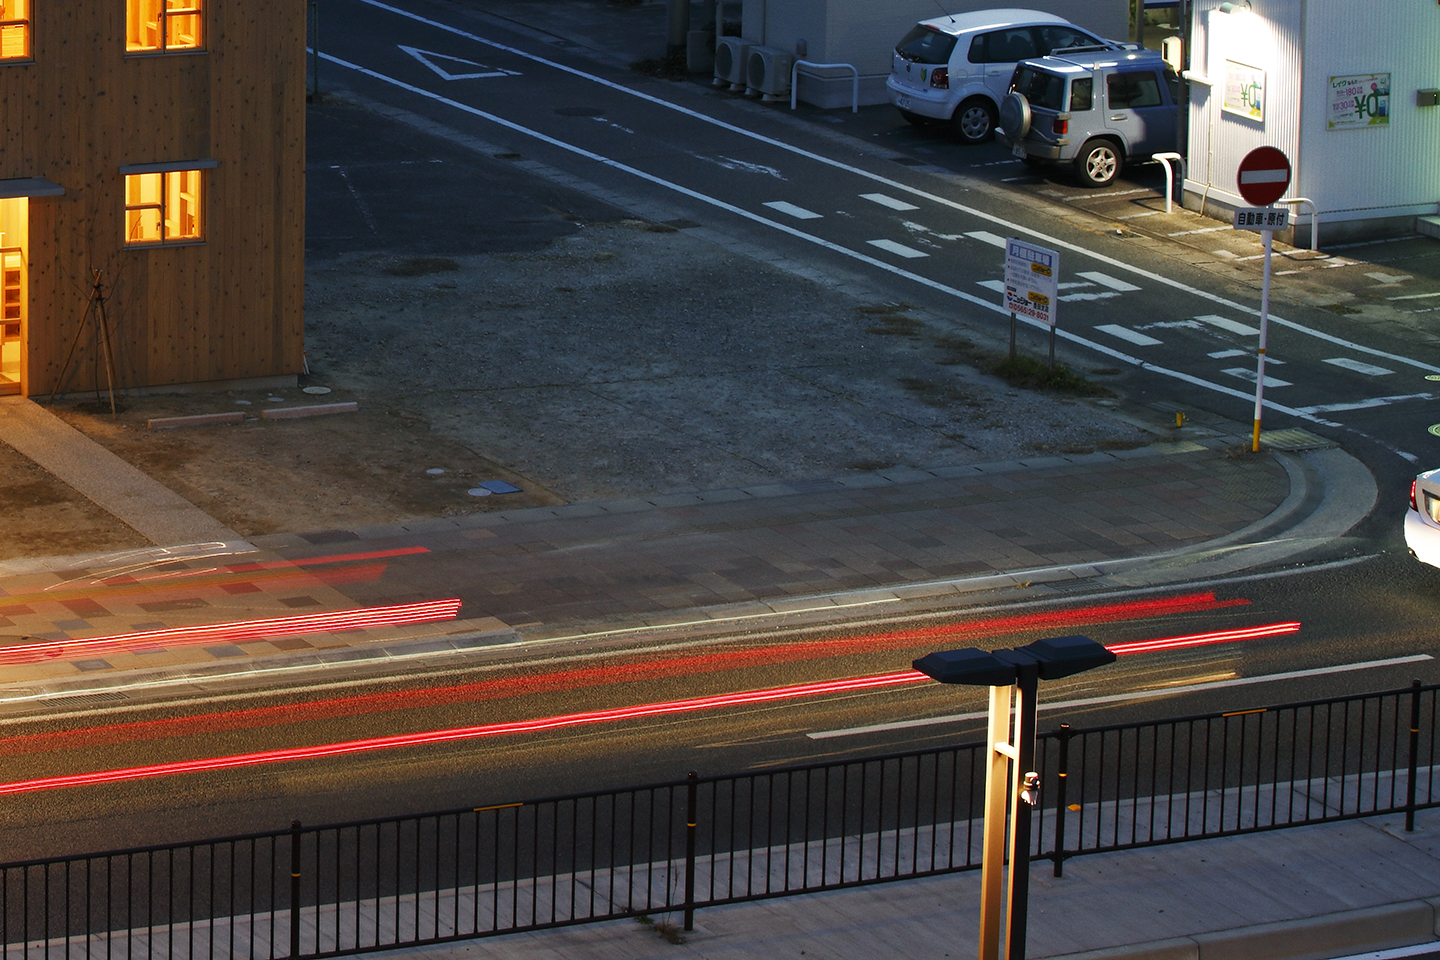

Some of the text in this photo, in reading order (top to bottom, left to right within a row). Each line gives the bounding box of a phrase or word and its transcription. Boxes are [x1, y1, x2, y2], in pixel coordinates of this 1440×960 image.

[1241, 83, 1257, 108] ¥0
[1354, 93, 1379, 119] ¥0
[1238, 212, 1285, 226] 自動車・原付
